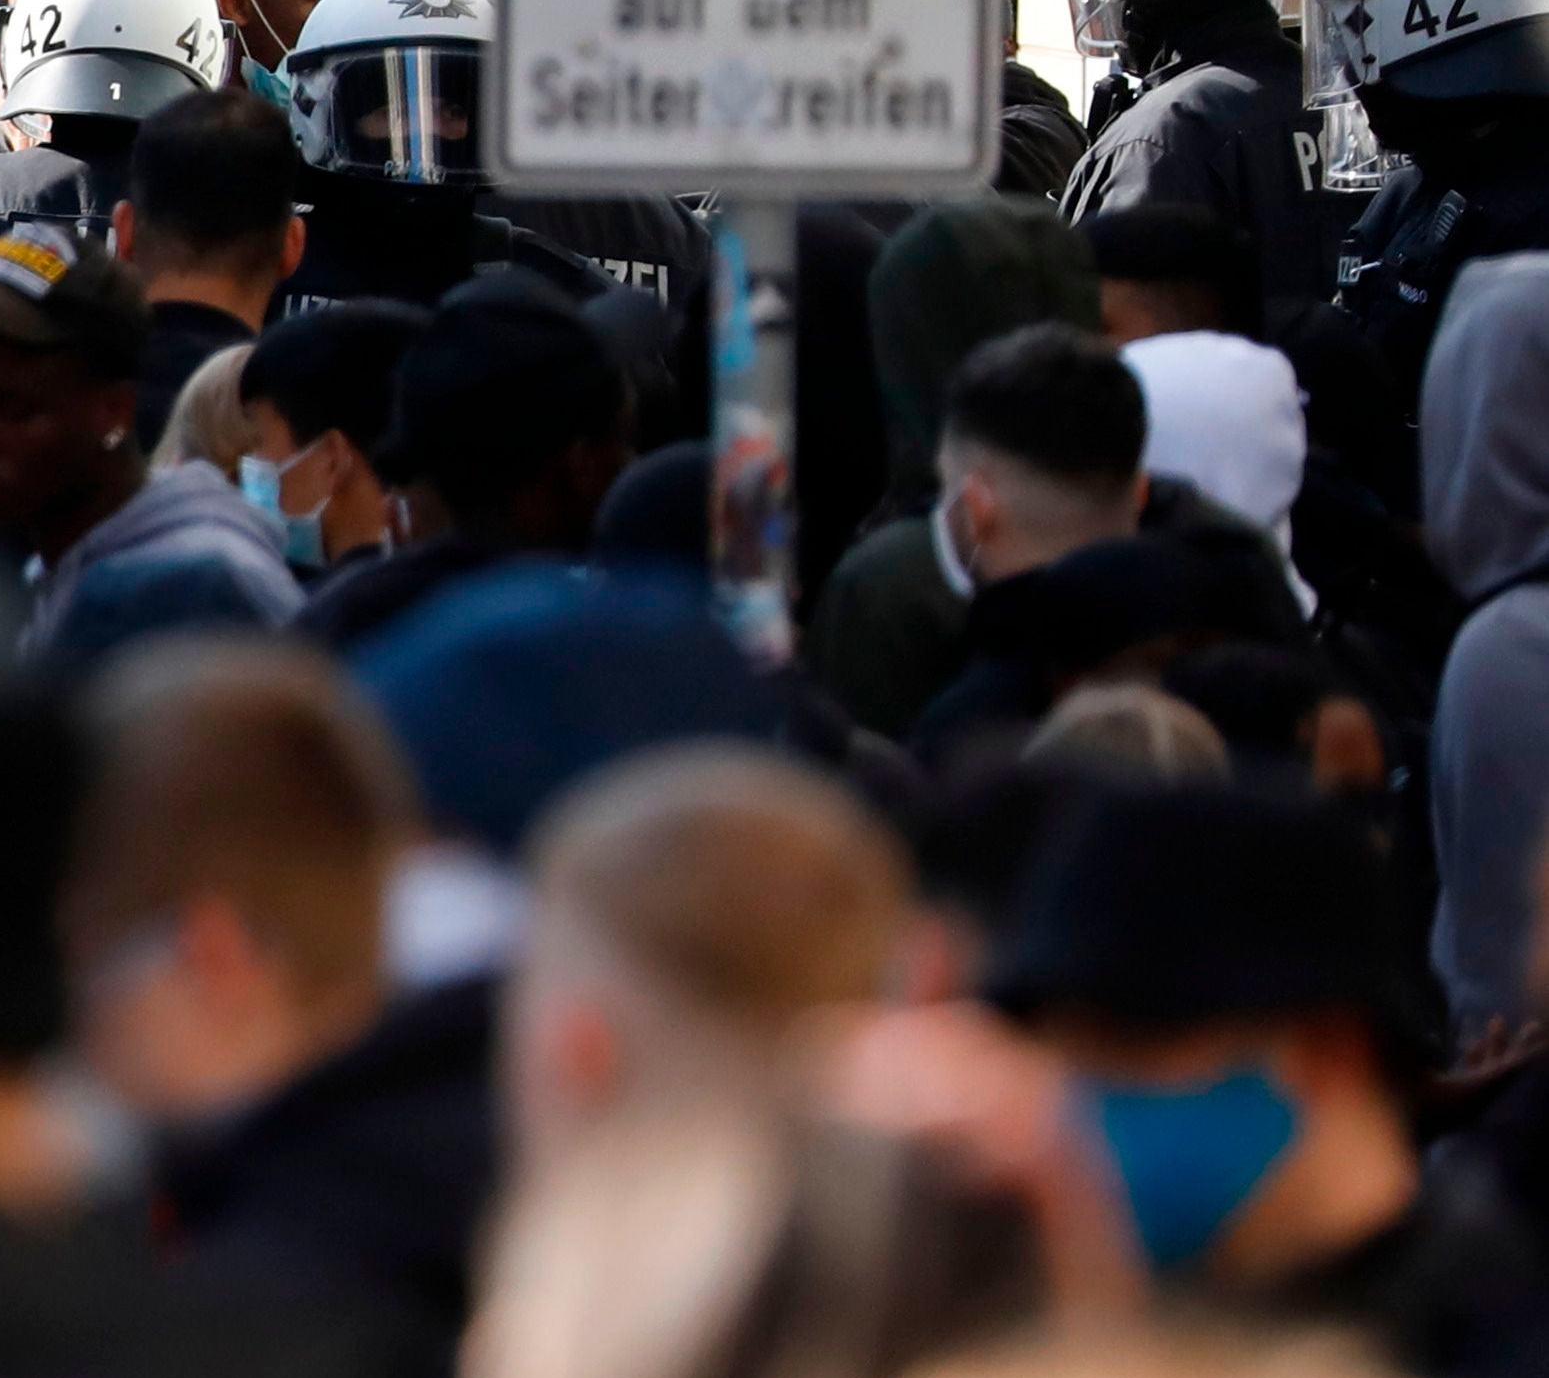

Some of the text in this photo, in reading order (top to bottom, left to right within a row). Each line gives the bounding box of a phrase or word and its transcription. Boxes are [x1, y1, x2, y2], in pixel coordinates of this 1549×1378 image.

[20, 4, 67, 58] 42
[175, 17, 219, 81] 42
[109, 82, 122, 101] 1
[531, 56, 951, 130] Seitenreifen
